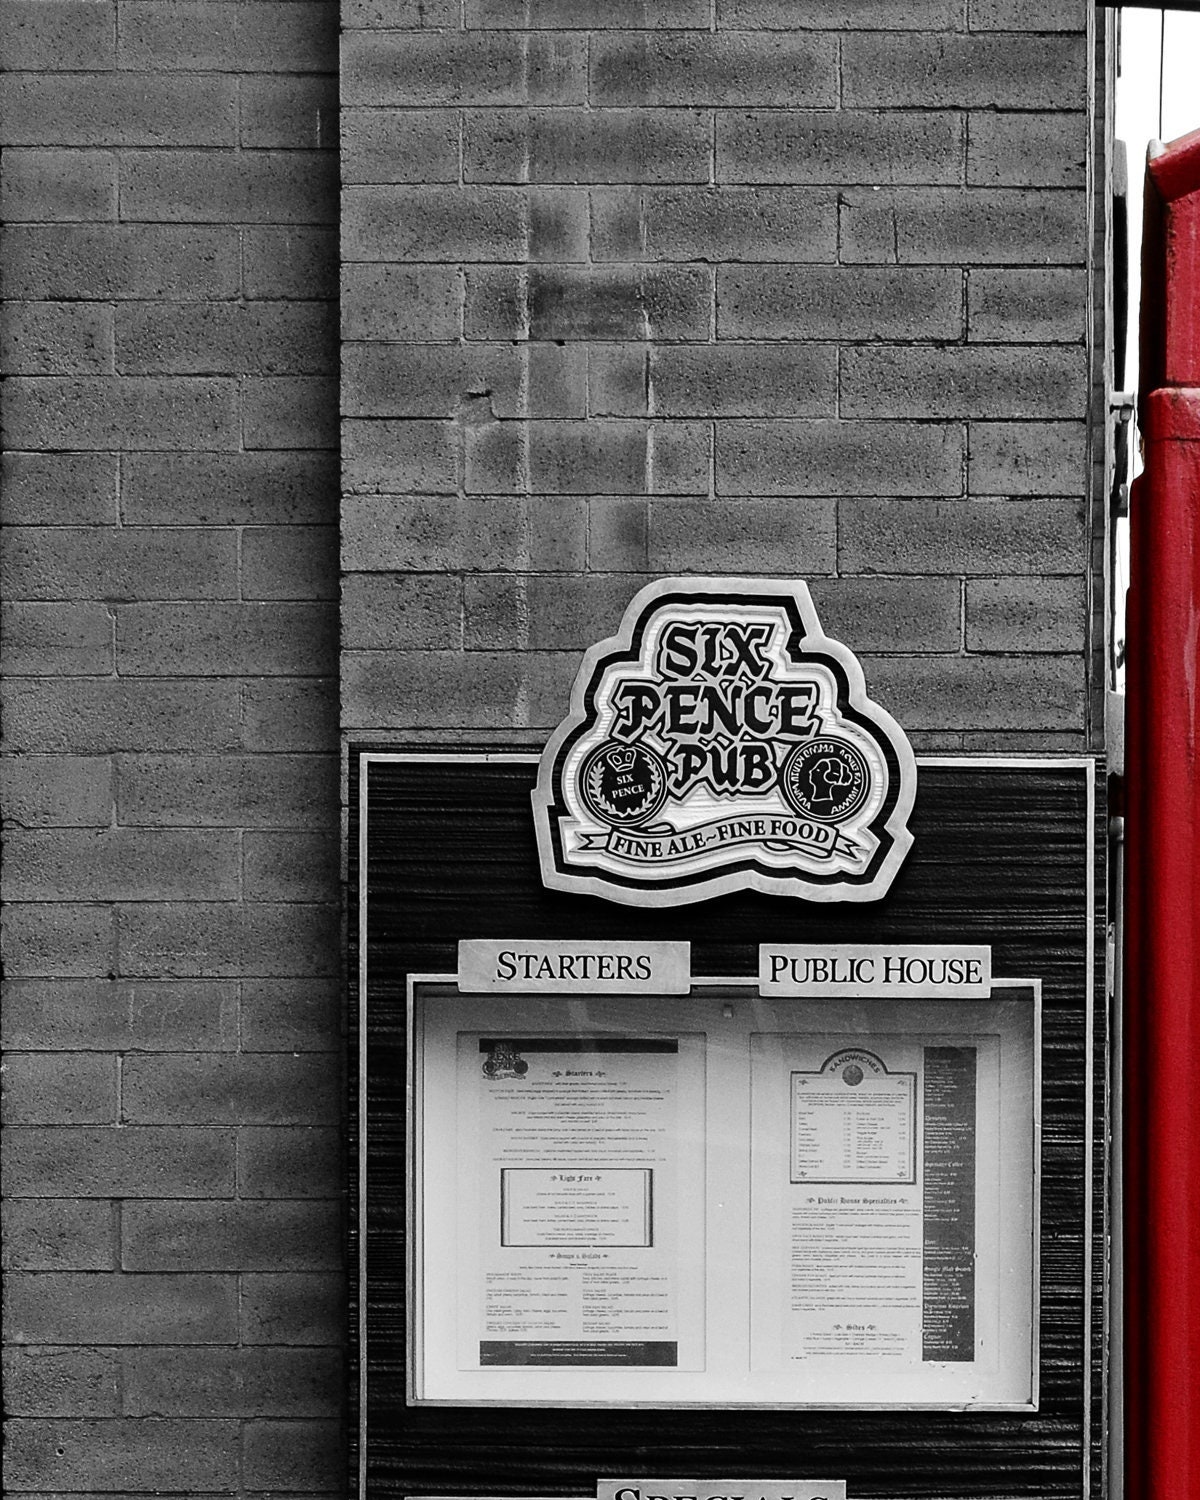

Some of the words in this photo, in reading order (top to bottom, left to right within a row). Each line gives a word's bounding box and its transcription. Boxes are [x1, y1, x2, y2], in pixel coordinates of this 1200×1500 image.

[665, 625, 770, 678] SIX
[618, 684, 817, 738] PENCE
[616, 774, 634, 785] SIX
[669, 741, 777, 792] PUB
[611, 784, 645, 799] PENCE
[613, 837, 664, 858] FINE
[769, 821, 830, 844] FOOD
[497, 951, 651, 980] STARTERS
[769, 955, 874, 983] PUBLIC
[882, 958, 983, 984] HOUSE
